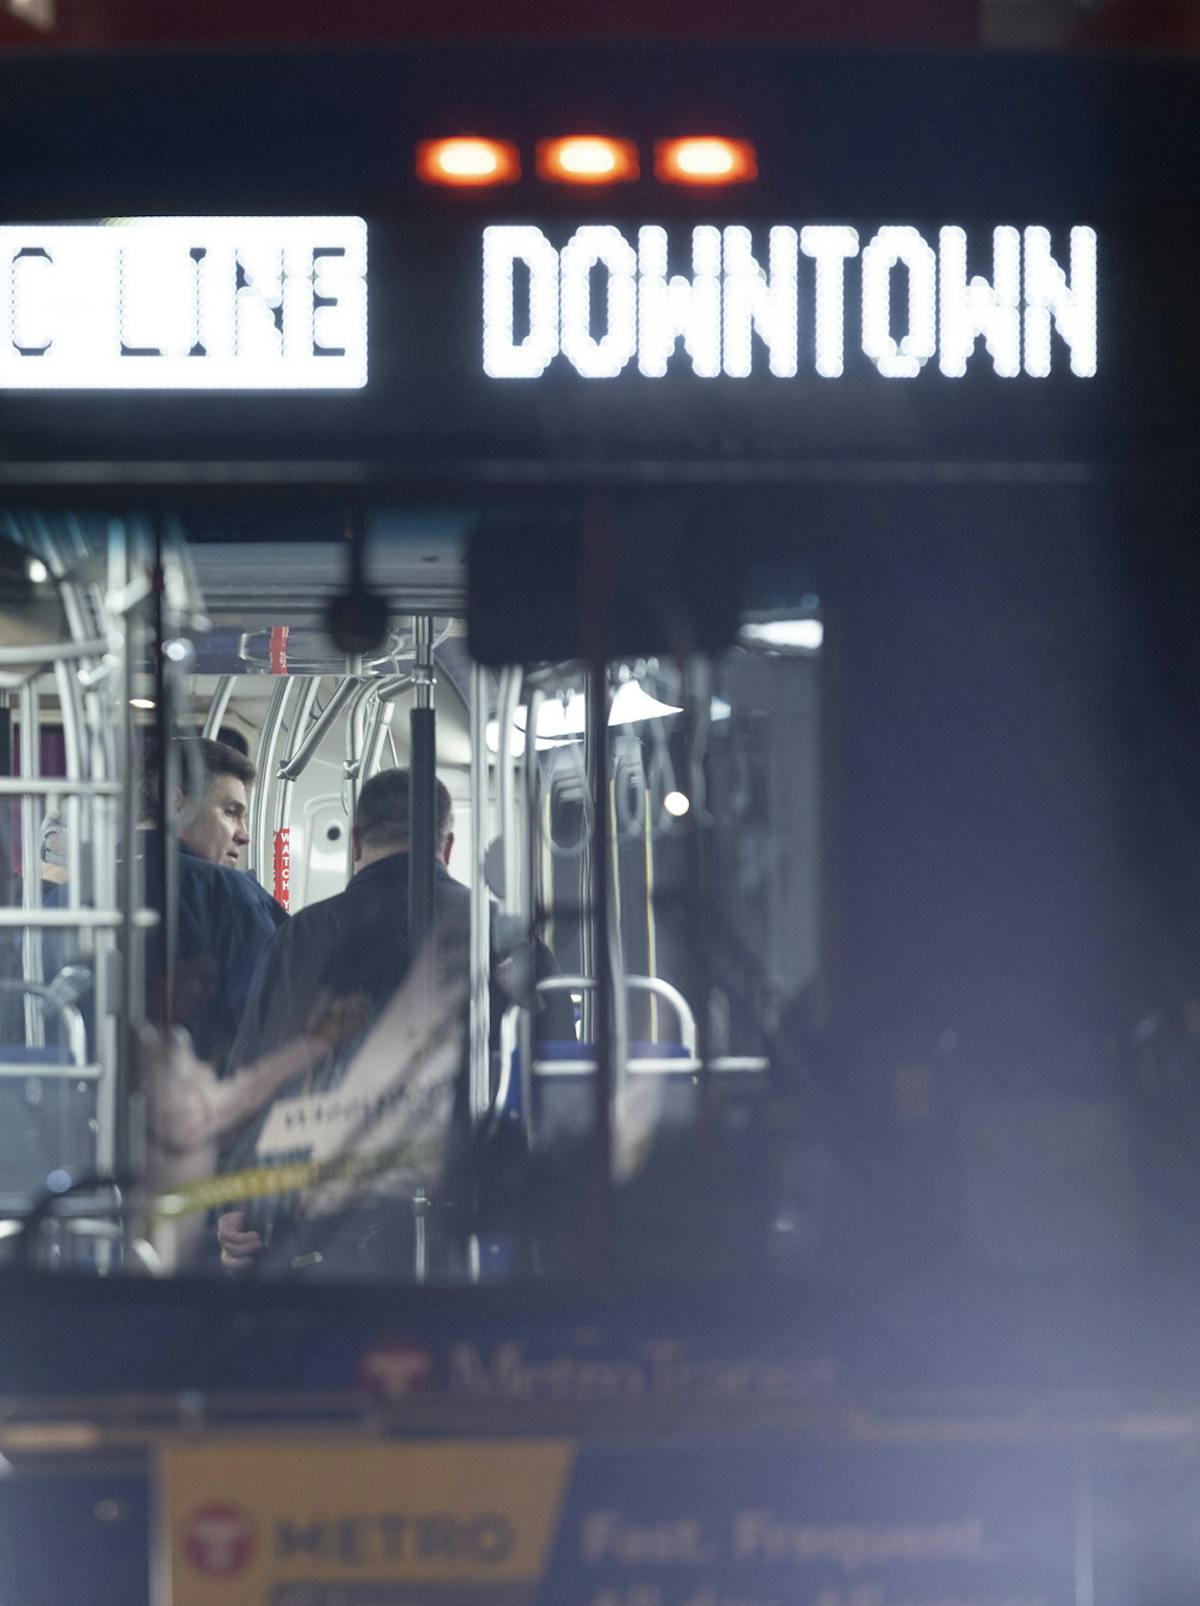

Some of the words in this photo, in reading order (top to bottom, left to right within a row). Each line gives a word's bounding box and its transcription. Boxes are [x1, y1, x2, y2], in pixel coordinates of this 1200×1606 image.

[11, 245, 54, 357] C
[118, 246, 346, 357] LINE
[482, 225, 1097, 378] DOWNTOWN
[280, 832, 290, 891] WATCH
[273, 1510, 517, 1566] METRO
